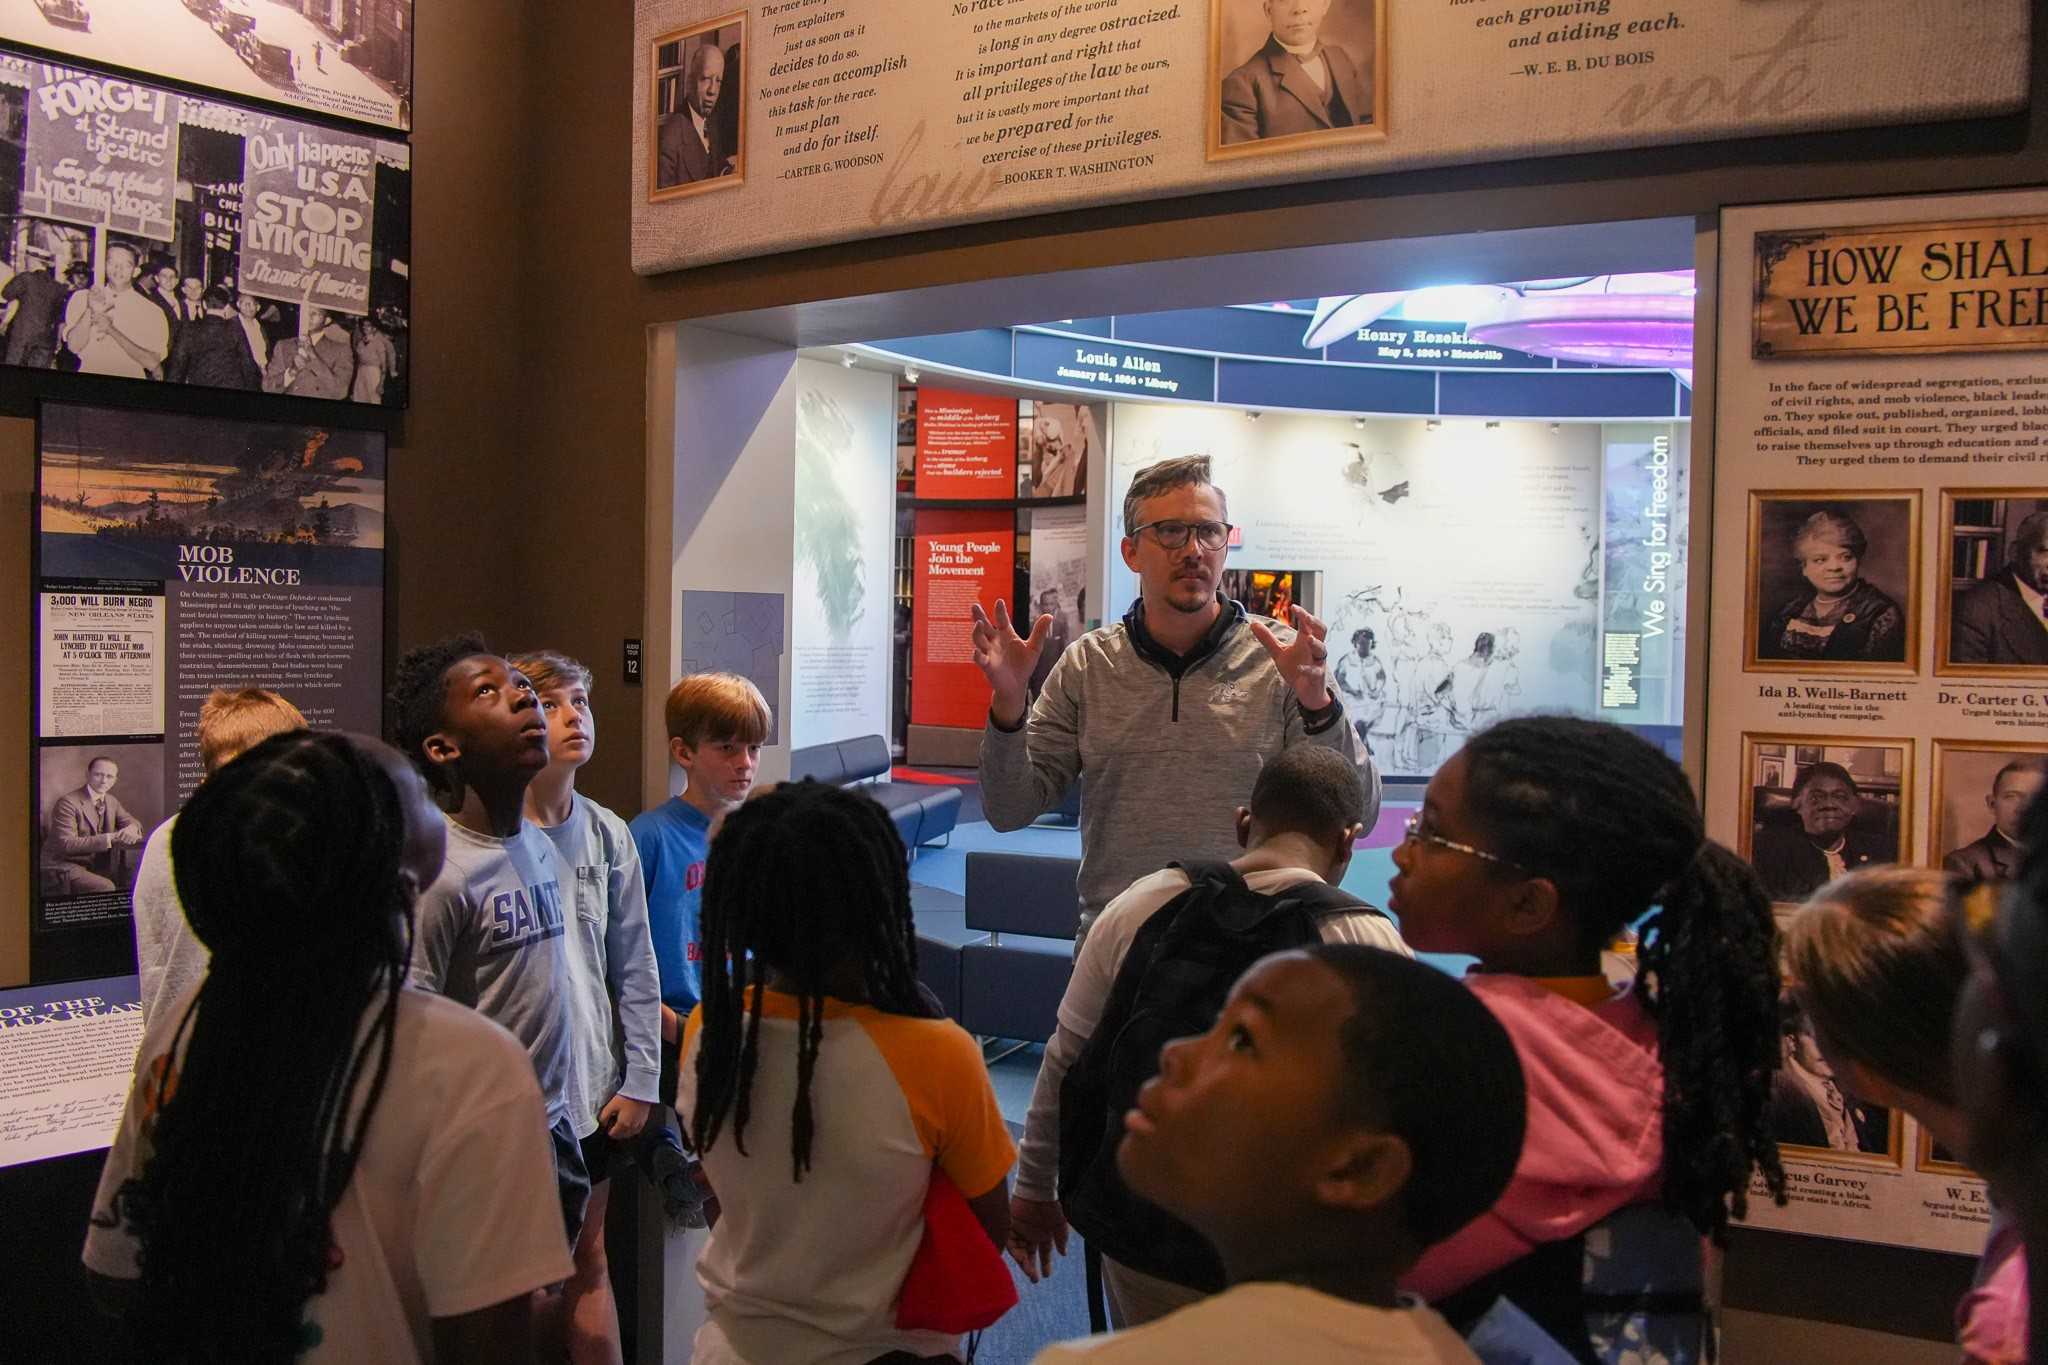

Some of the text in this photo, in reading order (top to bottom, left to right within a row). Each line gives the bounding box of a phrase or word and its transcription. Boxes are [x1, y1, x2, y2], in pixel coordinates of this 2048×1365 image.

[761, 5, 777, 17] The
[780, 3, 800, 12] race
[773, 10, 844, 37] from exploiters
[973, 24, 983, 33] to
[986, 19, 1002, 30] the
[1005, 11, 1048, 26] markets
[1051, 7, 1063, 19] of
[1064, 5, 1081, 15] the
[1476, 0, 1610, 27] each growing
[783, 25, 865, 55] just as soon as it
[978, 6, 1181, 54] is long in any degree ostracized.
[1508, 14, 1684, 48] and aiding each.
[769, 50, 859, 76] decides to do so.
[955, 39, 1140, 80] It is important and right that
[1510, 51, 1654, 76] —W. E. B. DU BOIS
[759, 55, 906, 100] No one else can accomplish
[962, 59, 1169, 101] all privileges of the law be ours,
[37, 78, 166, 124] FORGET
[768, 88, 876, 118] this task for the race.
[95, 113, 168, 150] Strand
[775, 115, 839, 136] It must plan
[966, 113, 1113, 144] we be prepared for the
[250, 132, 371, 171] Only happens
[783, 126, 878, 155] and do for itself.
[982, 129, 1161, 164] exercise of these privileges.
[776, 153, 884, 179] —CARTER G. WOODSON
[996, 154, 1153, 184] —BOOKER T. WASHINGTON
[255, 191, 363, 237] STOP
[247, 219, 372, 271] LYNCHING
[1807, 245, 1902, 287] HOW
[1789, 295, 1858, 335] WE
[1877, 292, 1929, 332] BE
[1357, 328, 1407, 345] Henry
[1076, 349, 1162, 373] Louis Allen
[1378, 347, 1401, 359] May
[1056, 366, 1098, 383] January
[1144, 377, 1179, 392] Liberty
[1769, 382, 1781, 392] In
[1785, 382, 1804, 391] the
[1807, 381, 1831, 390] face
[1835, 380, 1848, 390] of
[1851, 378, 1921, 390] widespread
[1925, 377, 2003, 389] segregation,
[1643, 520, 1667, 546] for
[178, 544, 234, 564] MOB
[928, 541, 1001, 553] Young People
[928, 553, 974, 563] Join the
[177, 565, 300, 586] VIOLENCE
[928, 564, 985, 576] Movement
[1644, 551, 1671, 593] Sing
[51, 595, 153, 608] 3,000 WILL BURN NEGRO
[1643, 599, 1665, 638] We
[627, 660, 638, 673] 12
[1759, 686, 1907, 702] Ida B. Wells-Barnett
[1937, 692, 2039, 706] Dr. Carter G.
[493, 880, 564, 945] SAINT
[0, 996, 105, 1019] OF THE
[1814, 1173, 1868, 1190] Garvey
[1946, 1187, 1985, 1203] W. E.
